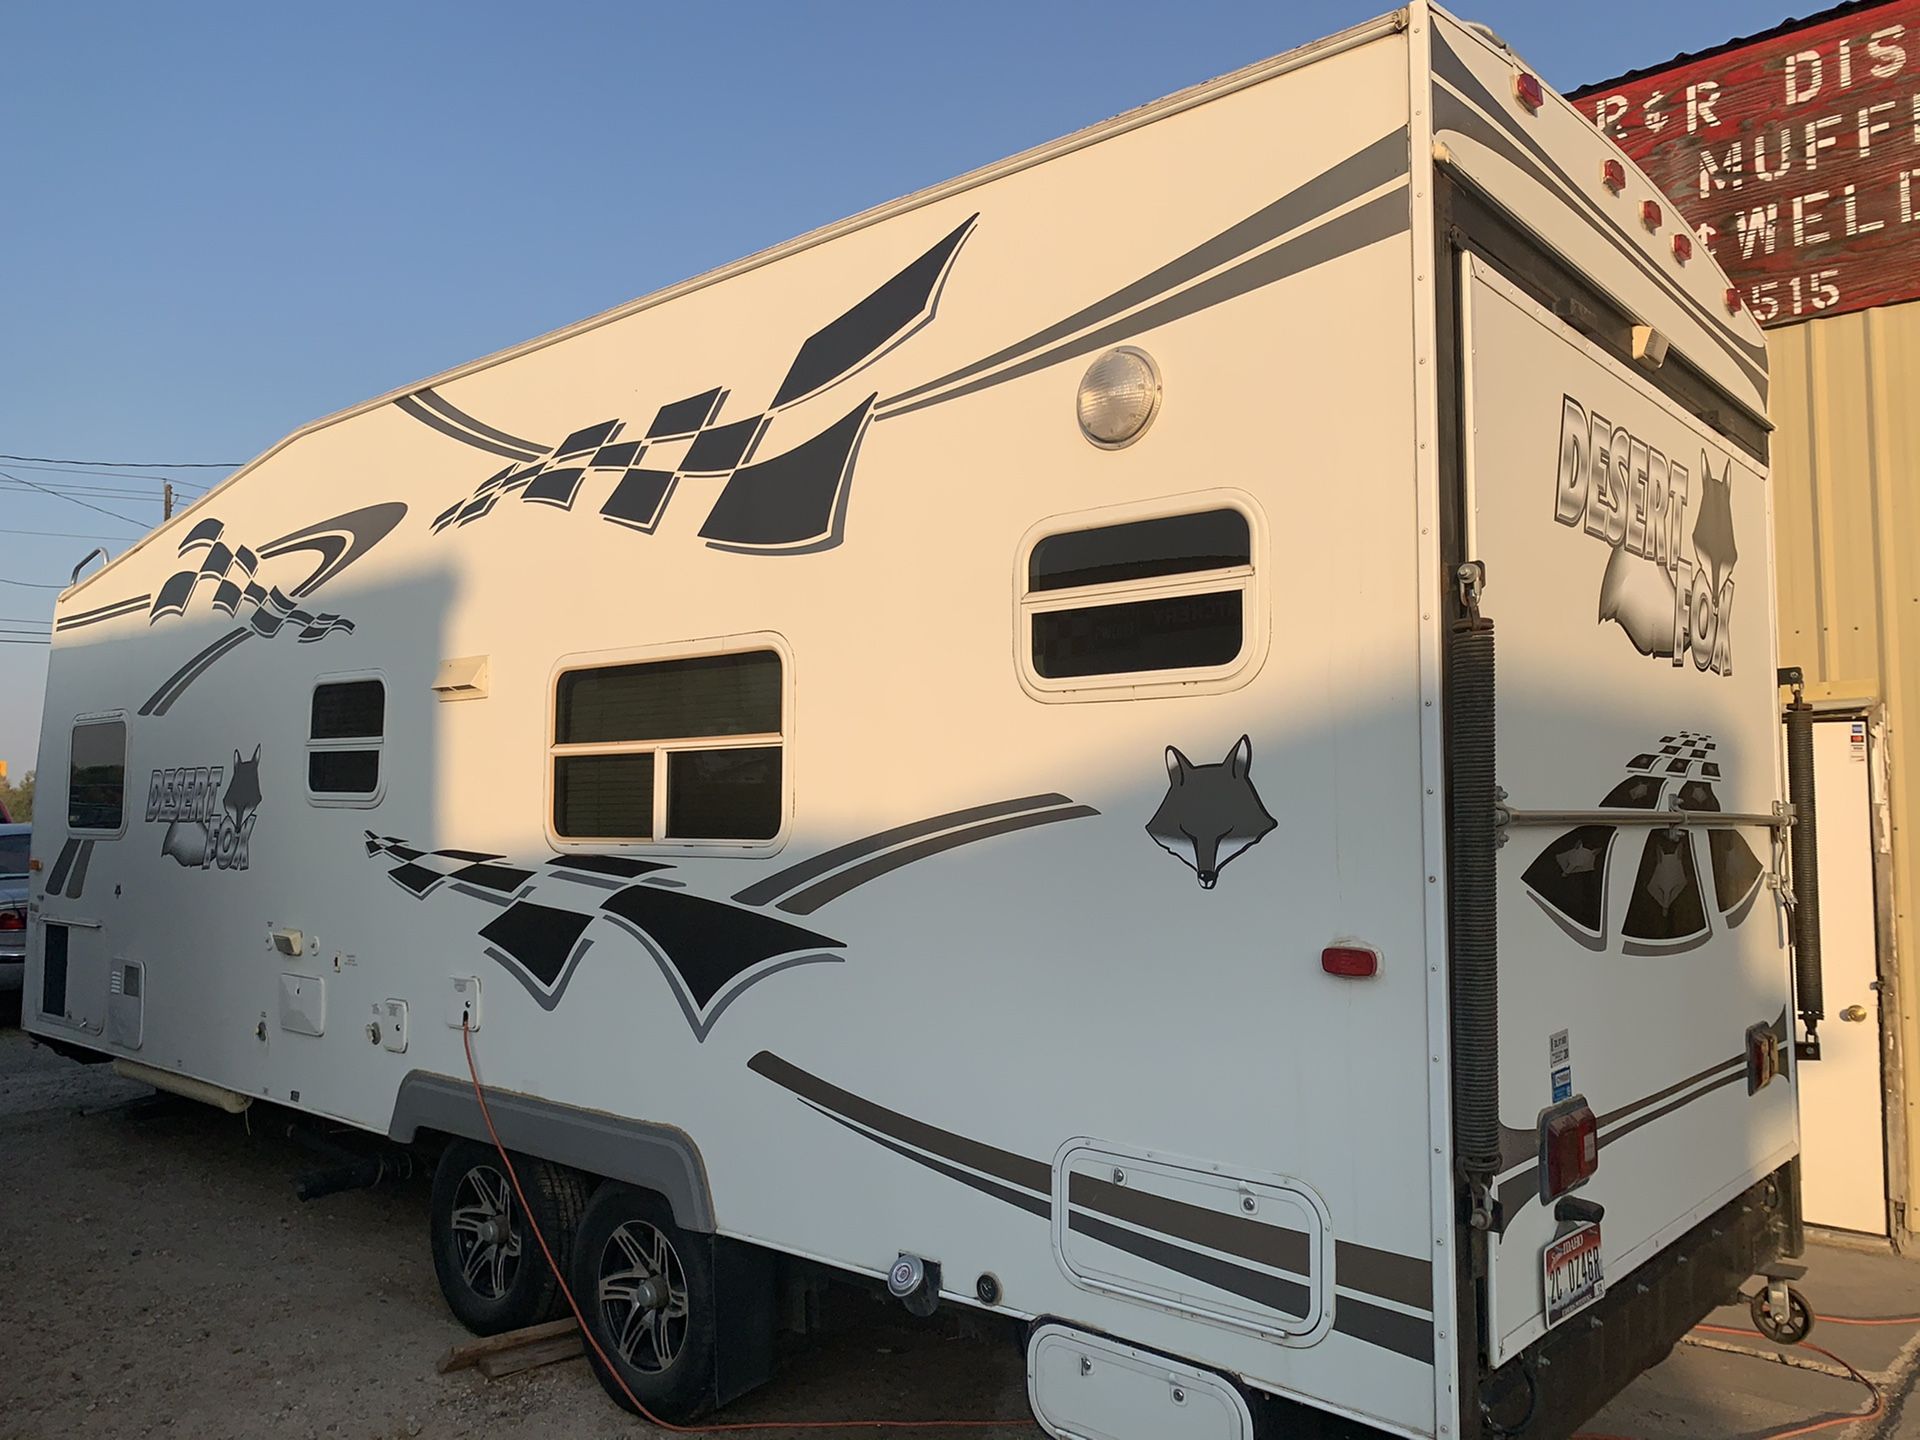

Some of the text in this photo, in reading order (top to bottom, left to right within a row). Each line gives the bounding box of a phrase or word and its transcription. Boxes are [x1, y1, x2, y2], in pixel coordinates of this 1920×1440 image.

[1700, 93, 1920, 199] MUFF
[1554, 393, 1689, 571] DESERT
[1672, 556, 1735, 677] FOX
[145, 766, 224, 823] DESERT
[202, 814, 257, 871] FOX
[1563, 1234, 1584, 1254] IDAHO
